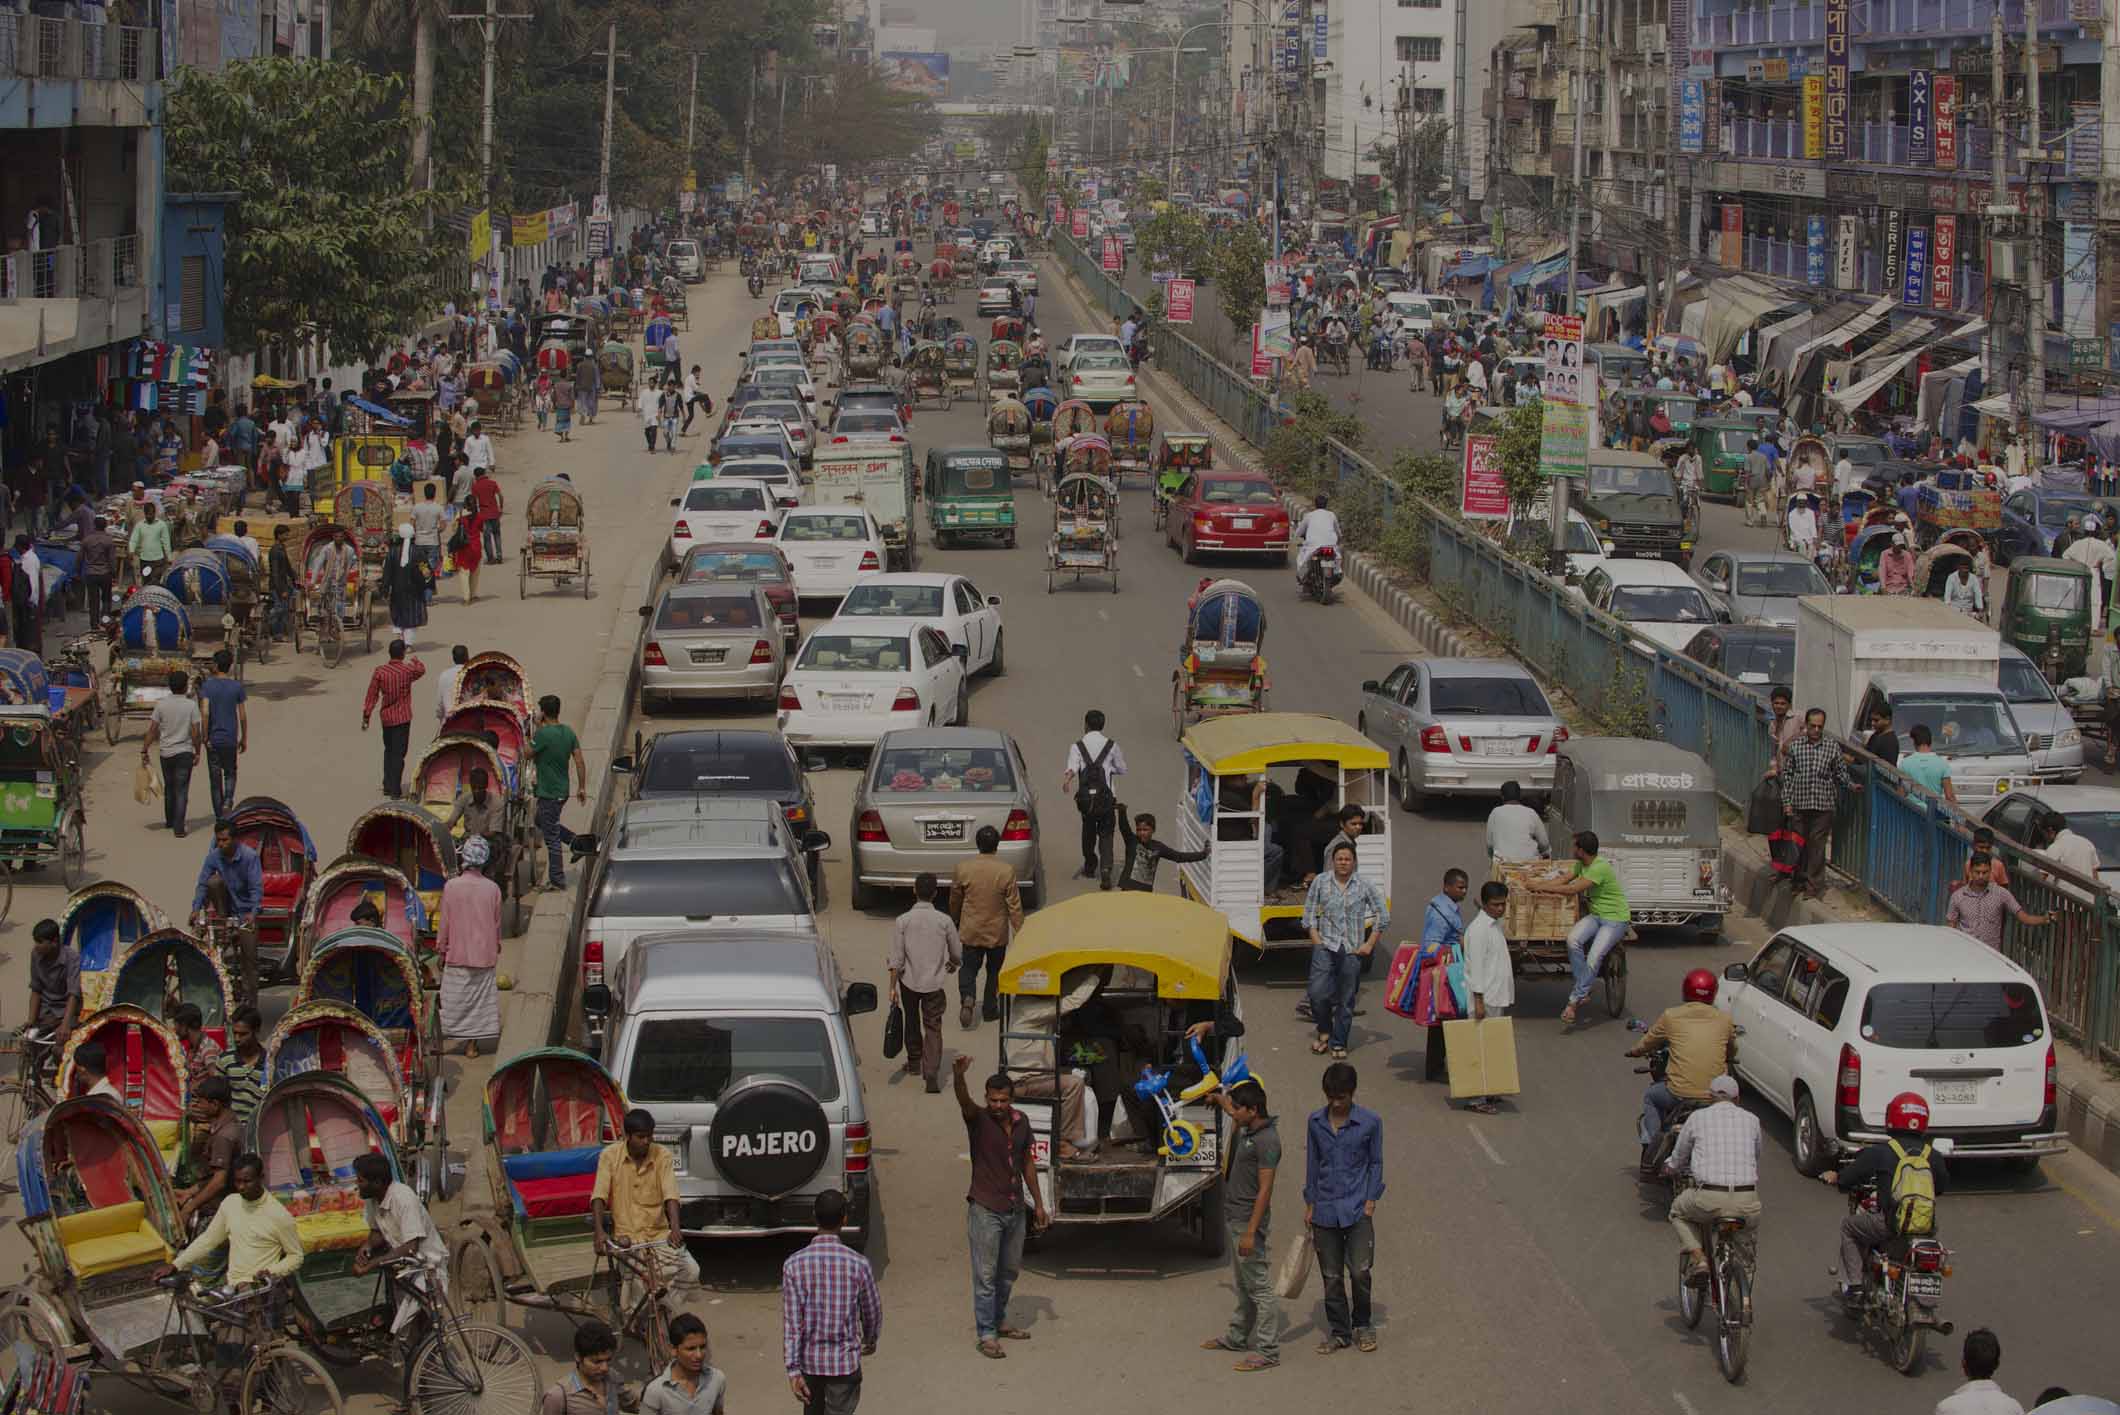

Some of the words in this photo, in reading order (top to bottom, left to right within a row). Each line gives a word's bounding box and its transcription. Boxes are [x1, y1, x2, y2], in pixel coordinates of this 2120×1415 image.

[1912, 71, 1927, 140] AXIS
[1886, 210, 1898, 288] PERFECT
[1621, 772, 1694, 789] প্রাইভেট
[722, 1129, 816, 1158] PAJERO
